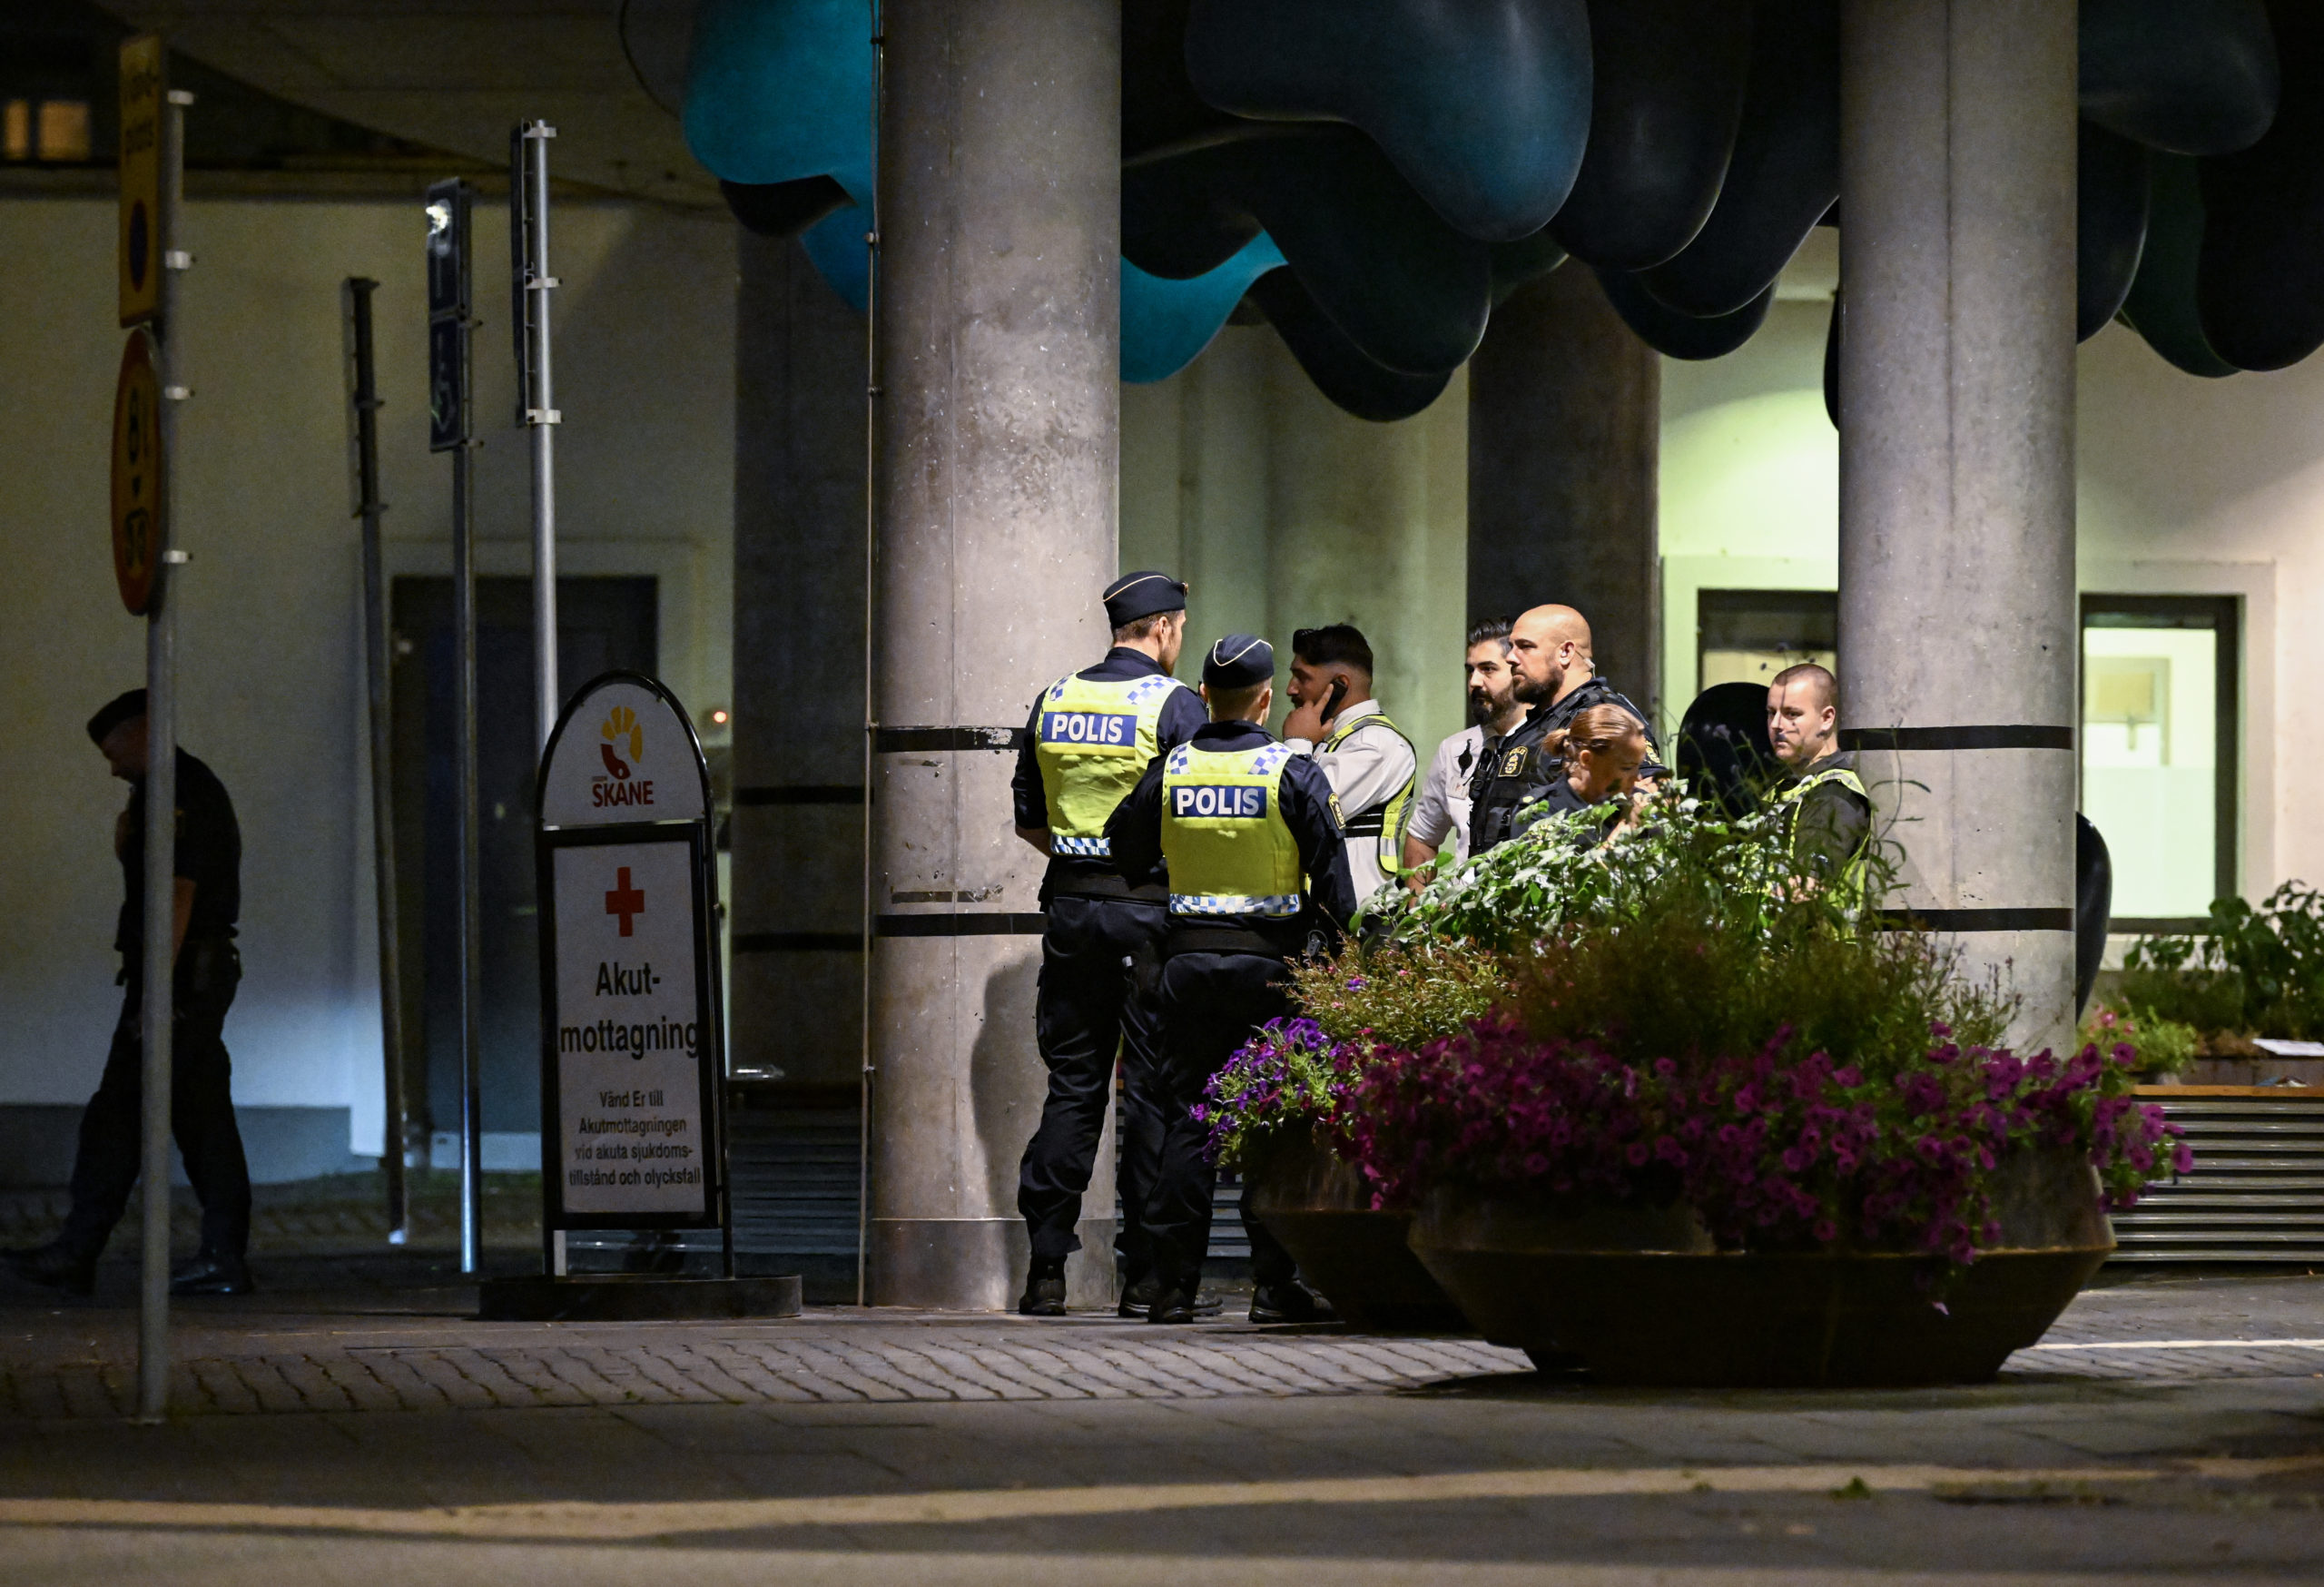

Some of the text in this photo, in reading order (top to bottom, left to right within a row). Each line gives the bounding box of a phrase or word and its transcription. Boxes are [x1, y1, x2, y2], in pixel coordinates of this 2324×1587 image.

[1051, 714, 1124, 744] POLIS
[1177, 788, 1259, 814] POLIS
[596, 961, 661, 996] Akut-
[560, 1015, 698, 1060] mottagning
[600, 1090, 664, 1108] Vänd Er till
[579, 1117, 687, 1137] Akutmottagningen
[576, 1142, 694, 1163] vid akuta sjukdoms-
[569, 1168, 701, 1188] tillstånd och olycksfall
